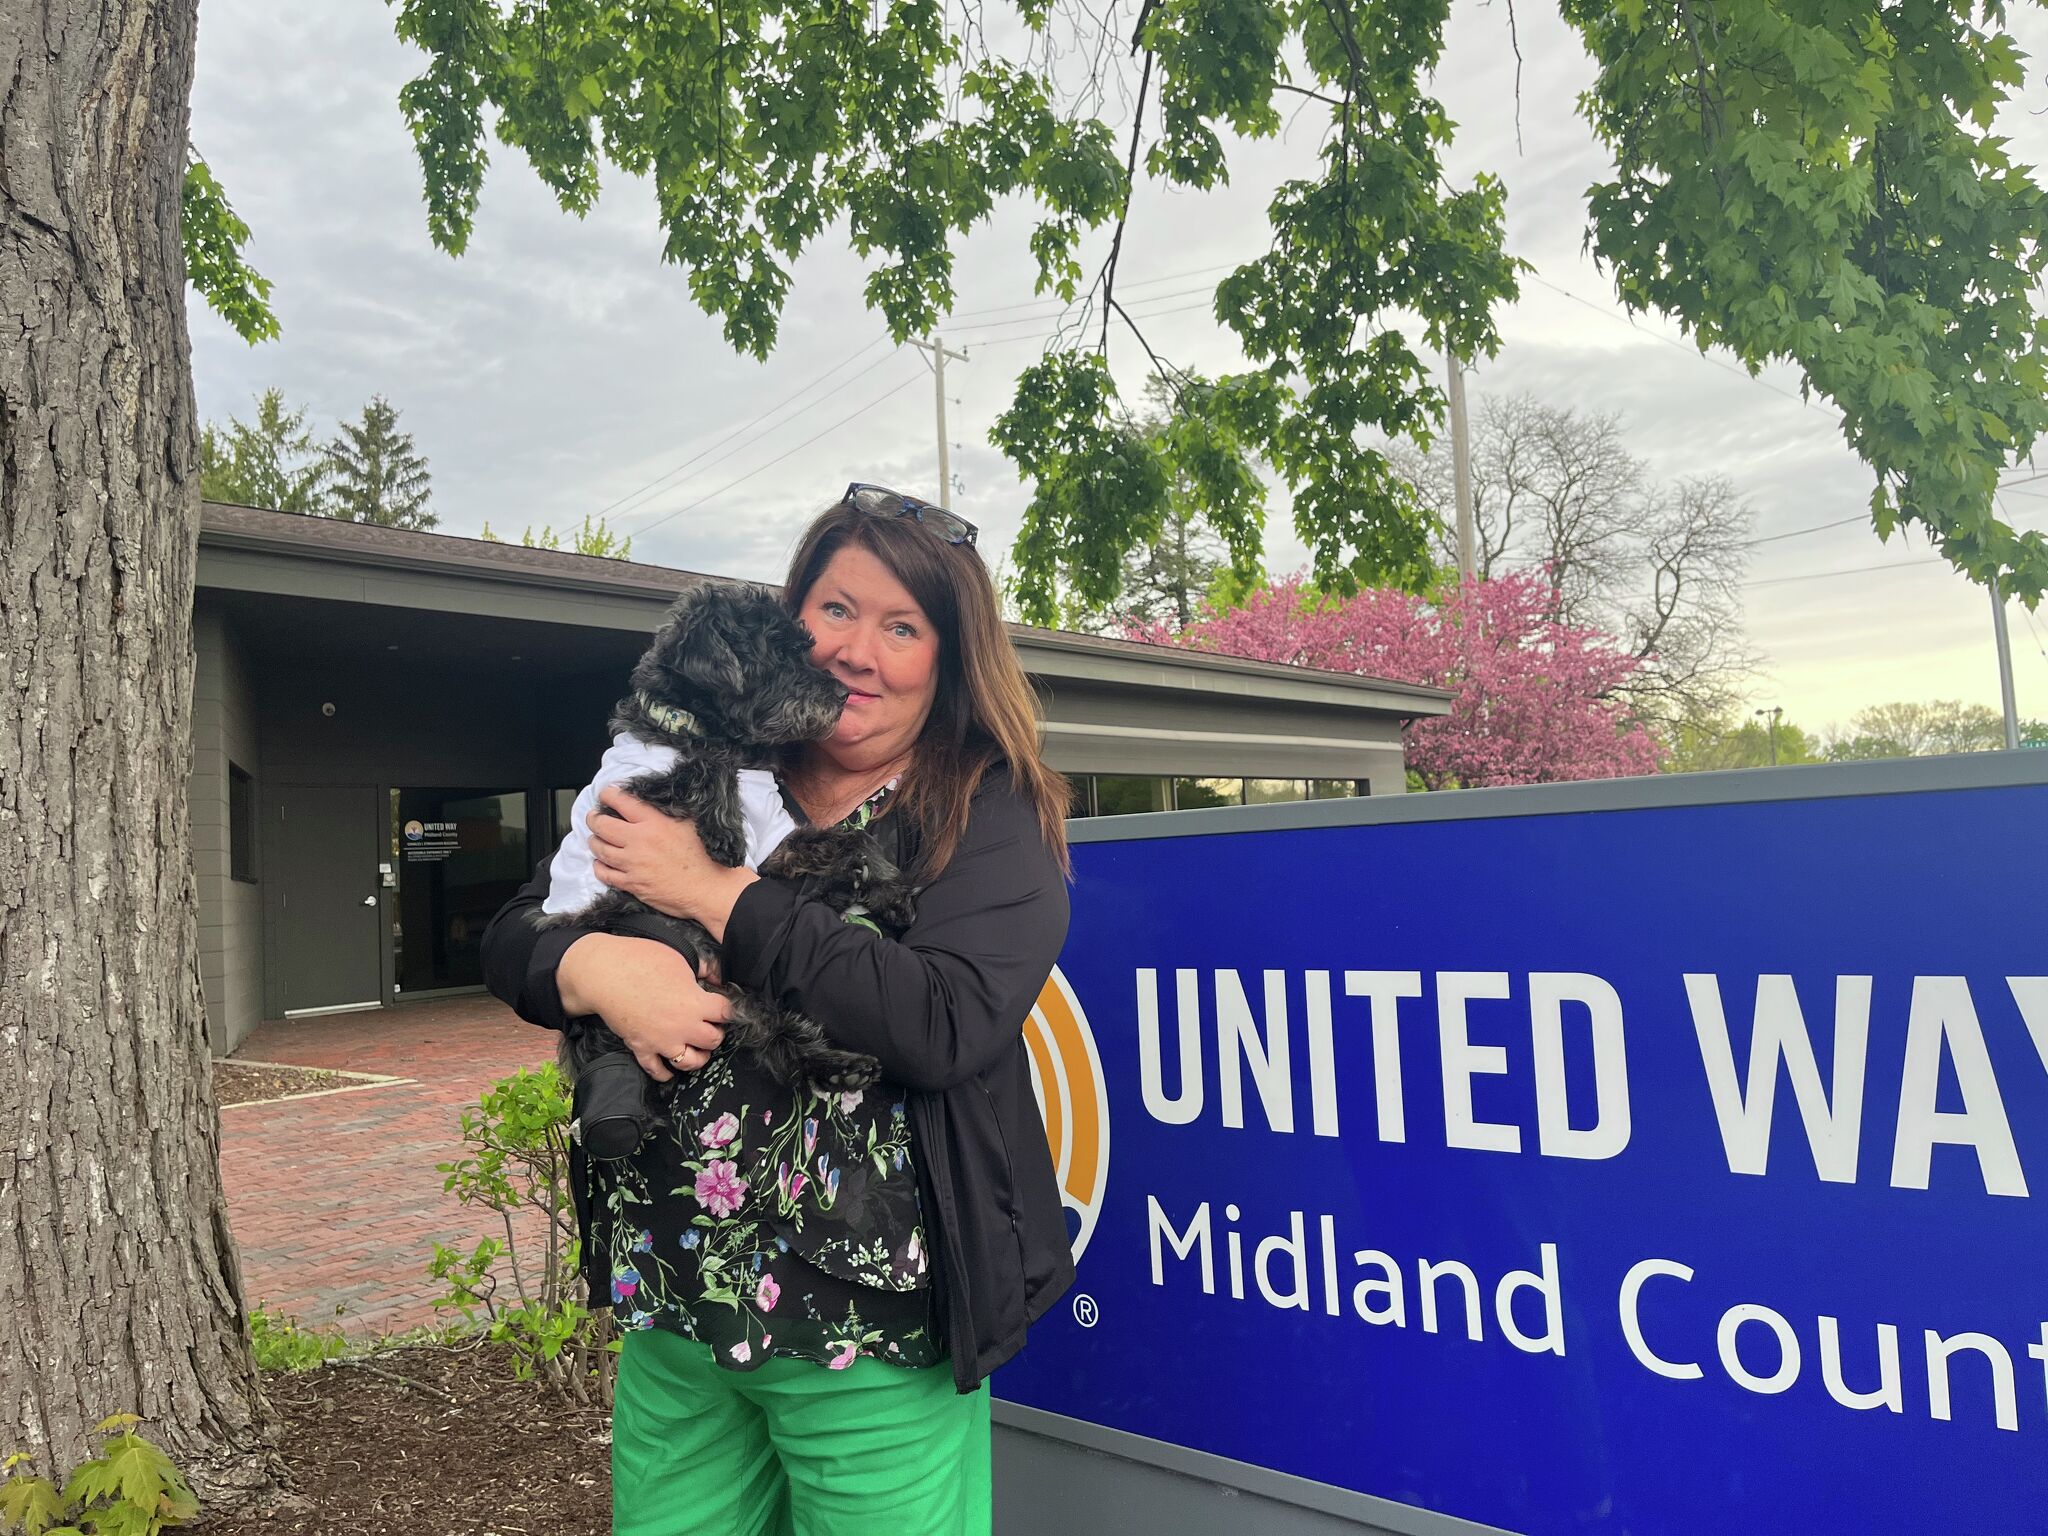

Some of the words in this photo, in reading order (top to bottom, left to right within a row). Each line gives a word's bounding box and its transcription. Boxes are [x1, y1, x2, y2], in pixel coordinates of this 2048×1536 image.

[424, 822, 444, 831] UNITED
[445, 822, 457, 831] WAY
[1134, 967, 1632, 1160] UNITED
[1147, 1194, 1566, 1357] Midland
